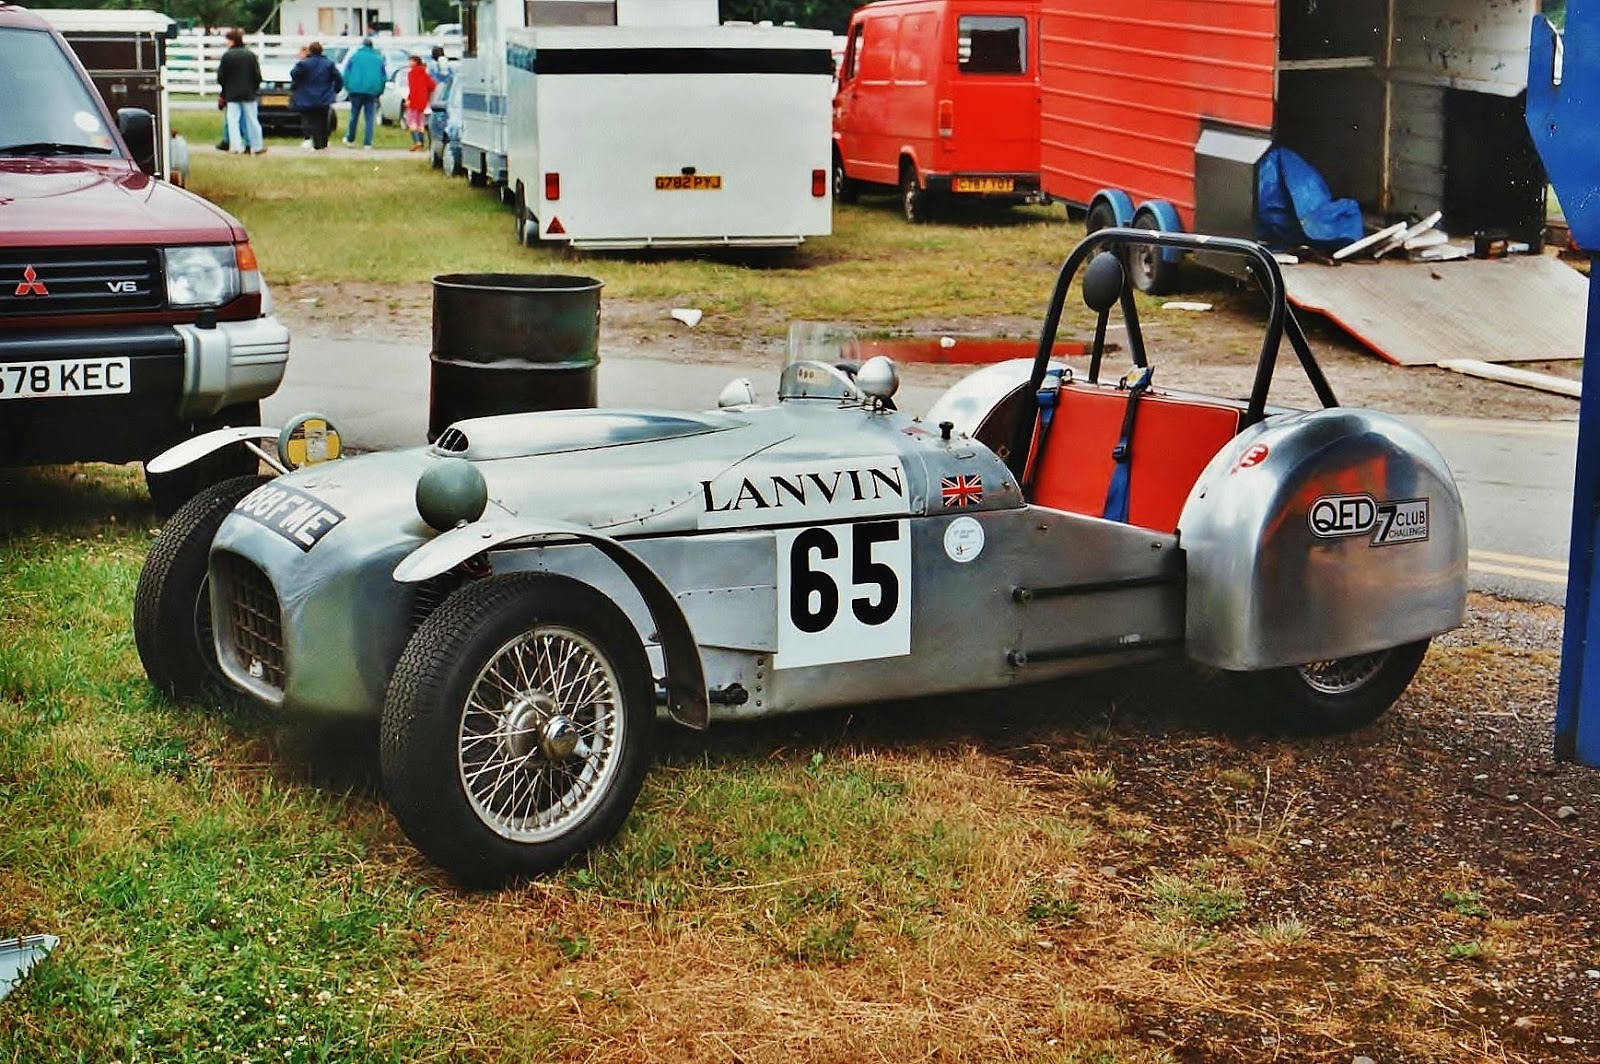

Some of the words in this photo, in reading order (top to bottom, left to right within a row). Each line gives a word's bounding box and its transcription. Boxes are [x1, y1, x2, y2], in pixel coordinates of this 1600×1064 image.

[655, 176, 691, 189] G782
[107, 281, 137, 292] V6
[0, 365, 50, 394] 78
[60, 362, 124, 391] KEC
[700, 467, 903, 512] LANVIN
[1313, 499, 1374, 533] QED
[1378, 505, 1397, 541] 7
[1396, 511, 1425, 527] CLUB
[790, 520, 899, 633] 65
